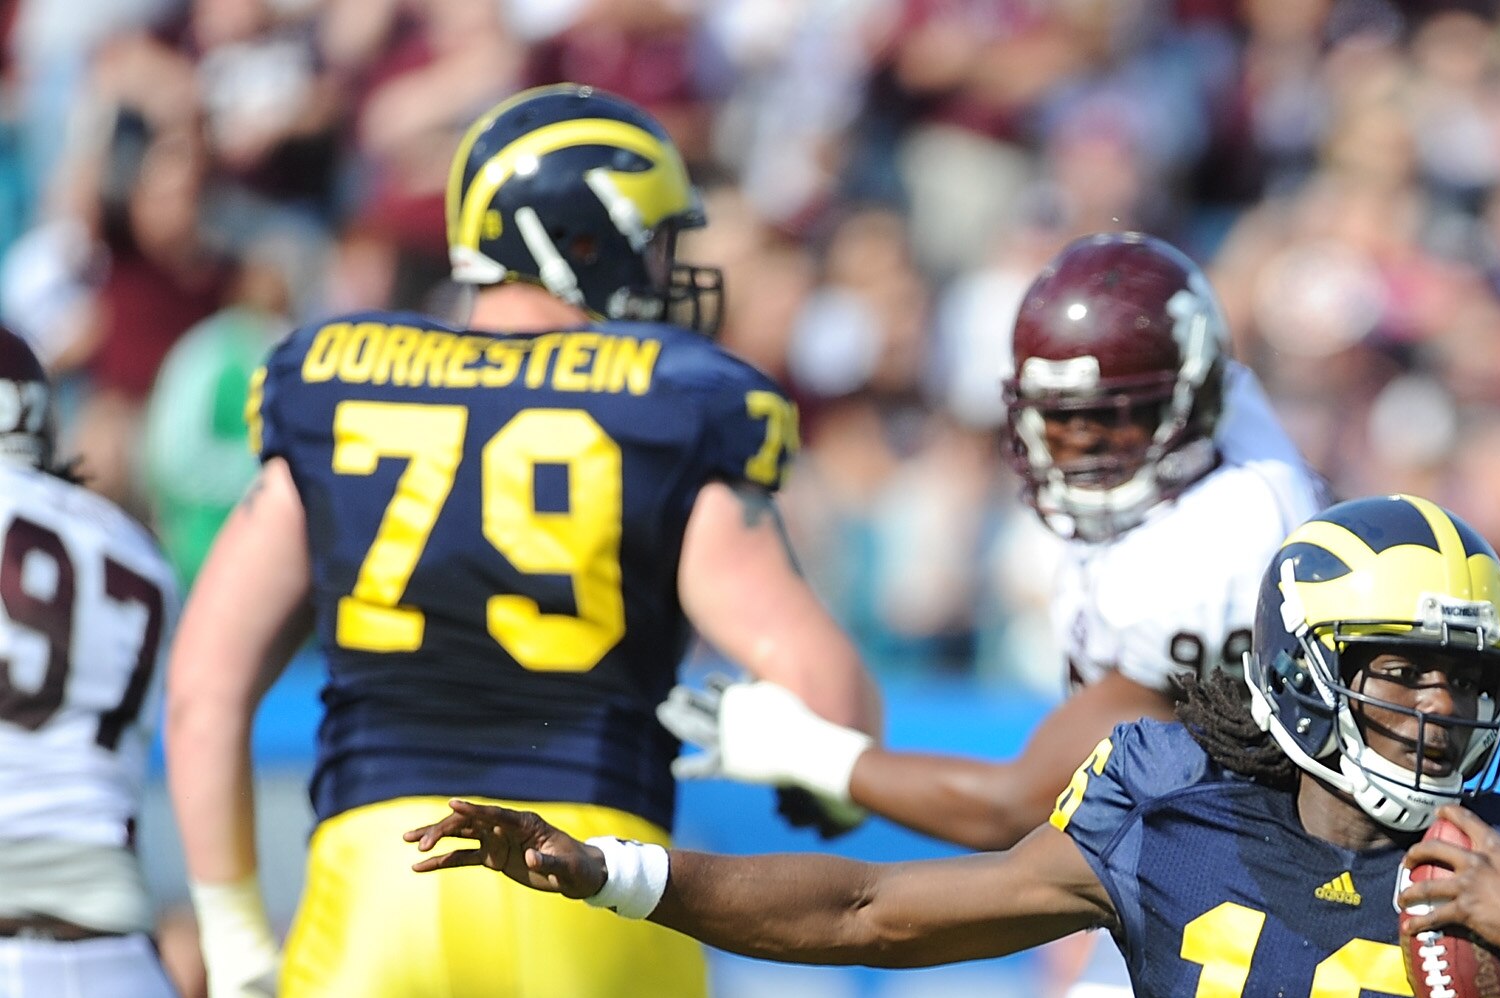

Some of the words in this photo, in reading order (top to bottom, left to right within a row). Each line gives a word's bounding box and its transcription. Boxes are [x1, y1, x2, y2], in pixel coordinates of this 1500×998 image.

[303, 322, 661, 396] DORRESTEIN
[333, 401, 626, 673] 79
[0, 516, 163, 751] 97
[1313, 886, 1362, 906] adidas
